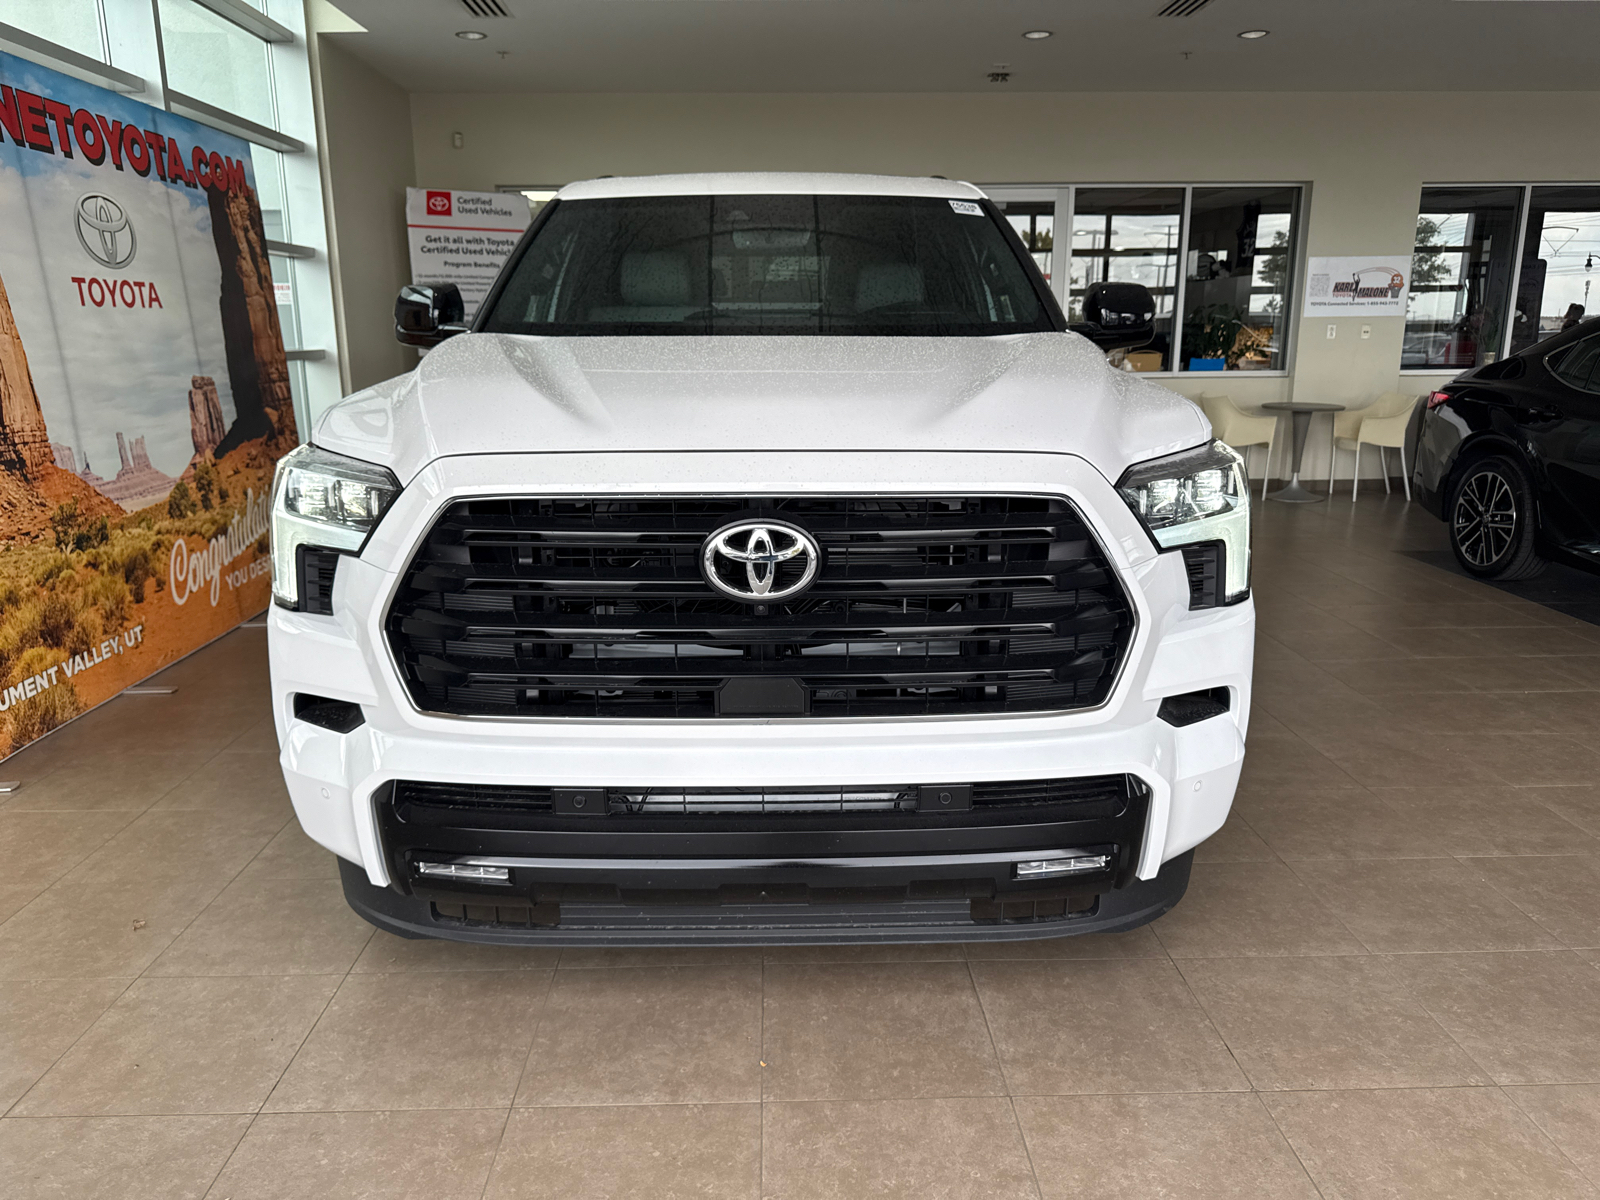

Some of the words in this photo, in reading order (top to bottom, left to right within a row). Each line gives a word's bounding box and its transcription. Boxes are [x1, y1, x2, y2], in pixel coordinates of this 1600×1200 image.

[457, 196, 492, 206] Certified
[458, 206, 478, 214] Used
[480, 207, 512, 217] Vehicles
[425, 235, 441, 244] Get
[444, 236, 450, 244] it
[452, 236, 463, 244] all
[465, 236, 485, 245] with
[487, 238, 515, 247] Toyota
[421, 245, 460, 254] Certified
[462, 247, 483, 255] Used
[1241, 238, 1256, 257] 32
[444, 261, 472, 269] Program
[71, 276, 163, 309] TOYOTA
[1333, 282, 1355, 292] KARL
[1357, 287, 1389, 298] MALONE
[225, 566, 249, 591] YOU
[61, 638, 123, 678] VALLEY,
[125, 625, 143, 647] UT
